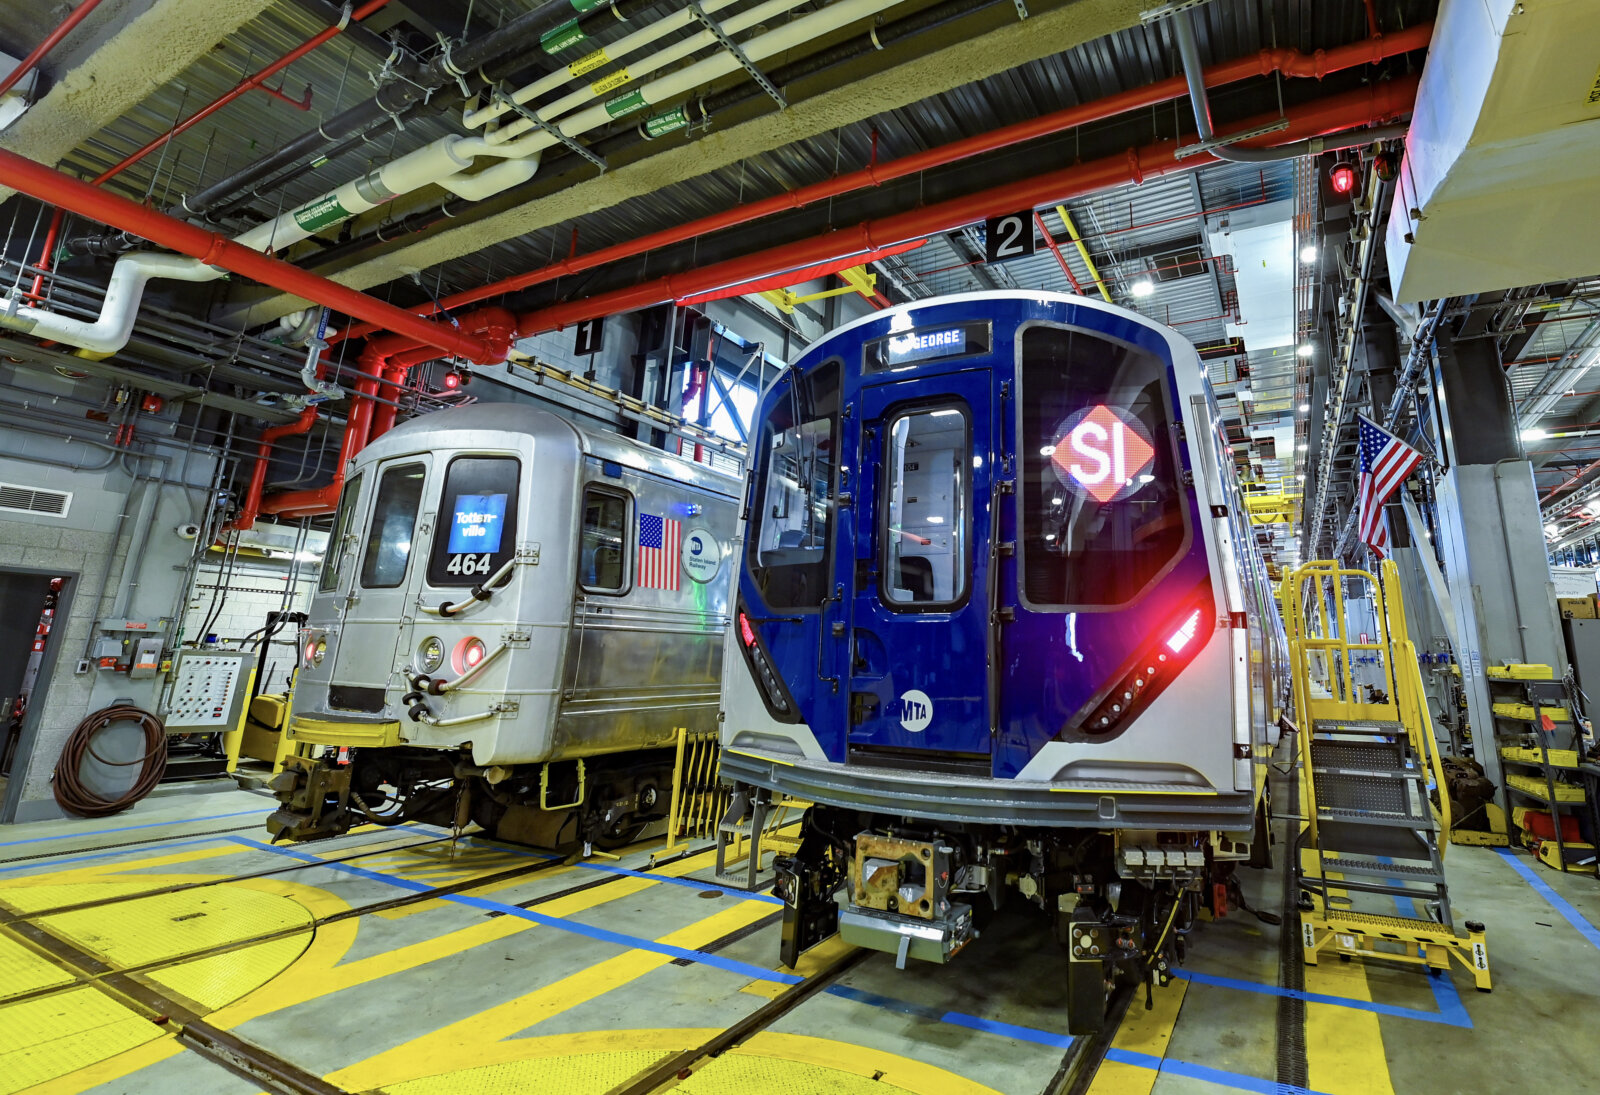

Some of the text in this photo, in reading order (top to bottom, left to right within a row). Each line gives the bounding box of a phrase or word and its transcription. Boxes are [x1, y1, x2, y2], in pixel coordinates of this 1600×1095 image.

[996, 216, 1024, 257] 2
[582, 320, 593, 350] 1
[913, 329, 960, 349] GEORGE
[1070, 421, 1126, 485] SI
[455, 512, 498, 524] Totten-
[462, 524, 487, 537] ville
[446, 553, 491, 576] 464
[900, 698, 927, 722] MTA
